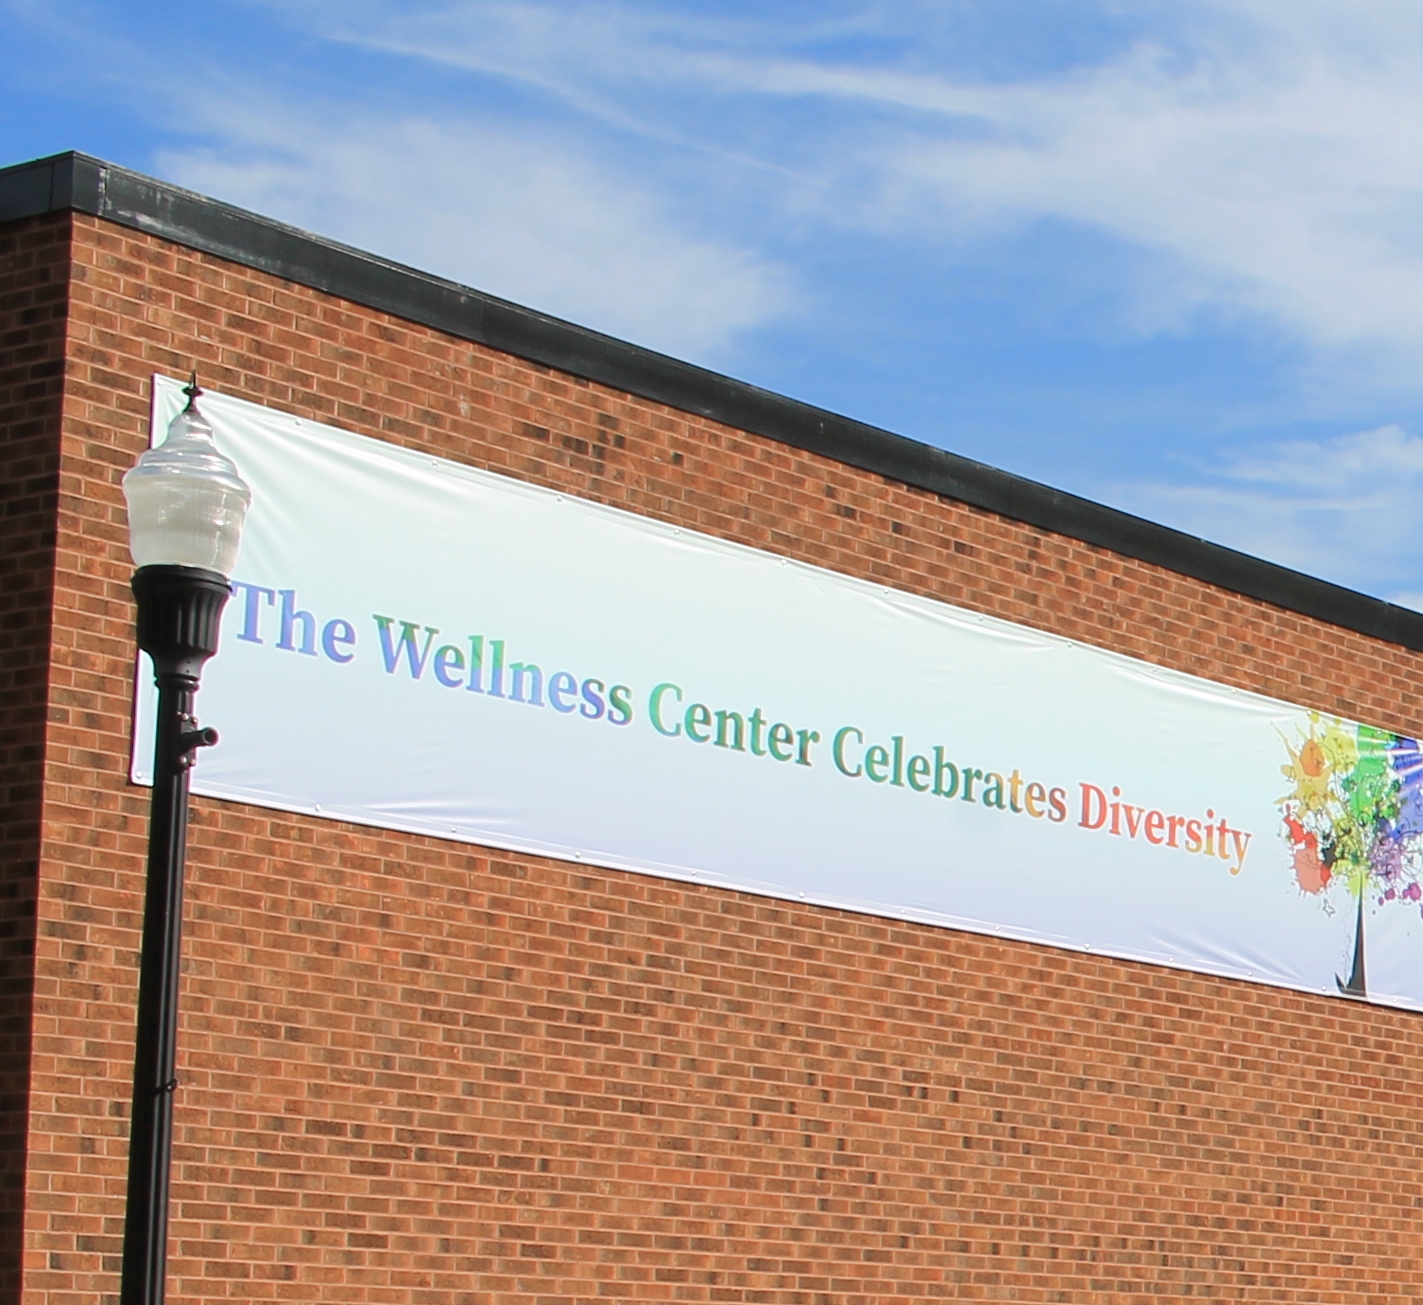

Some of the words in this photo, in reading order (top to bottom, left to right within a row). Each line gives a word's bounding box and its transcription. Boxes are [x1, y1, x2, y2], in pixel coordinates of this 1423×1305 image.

[230, 579, 357, 664] The
[371, 612, 633, 726] Wellness
[648, 682, 821, 767] Center
[832, 725, 1068, 823] Celebrates
[1077, 781, 1253, 876] Diversity
